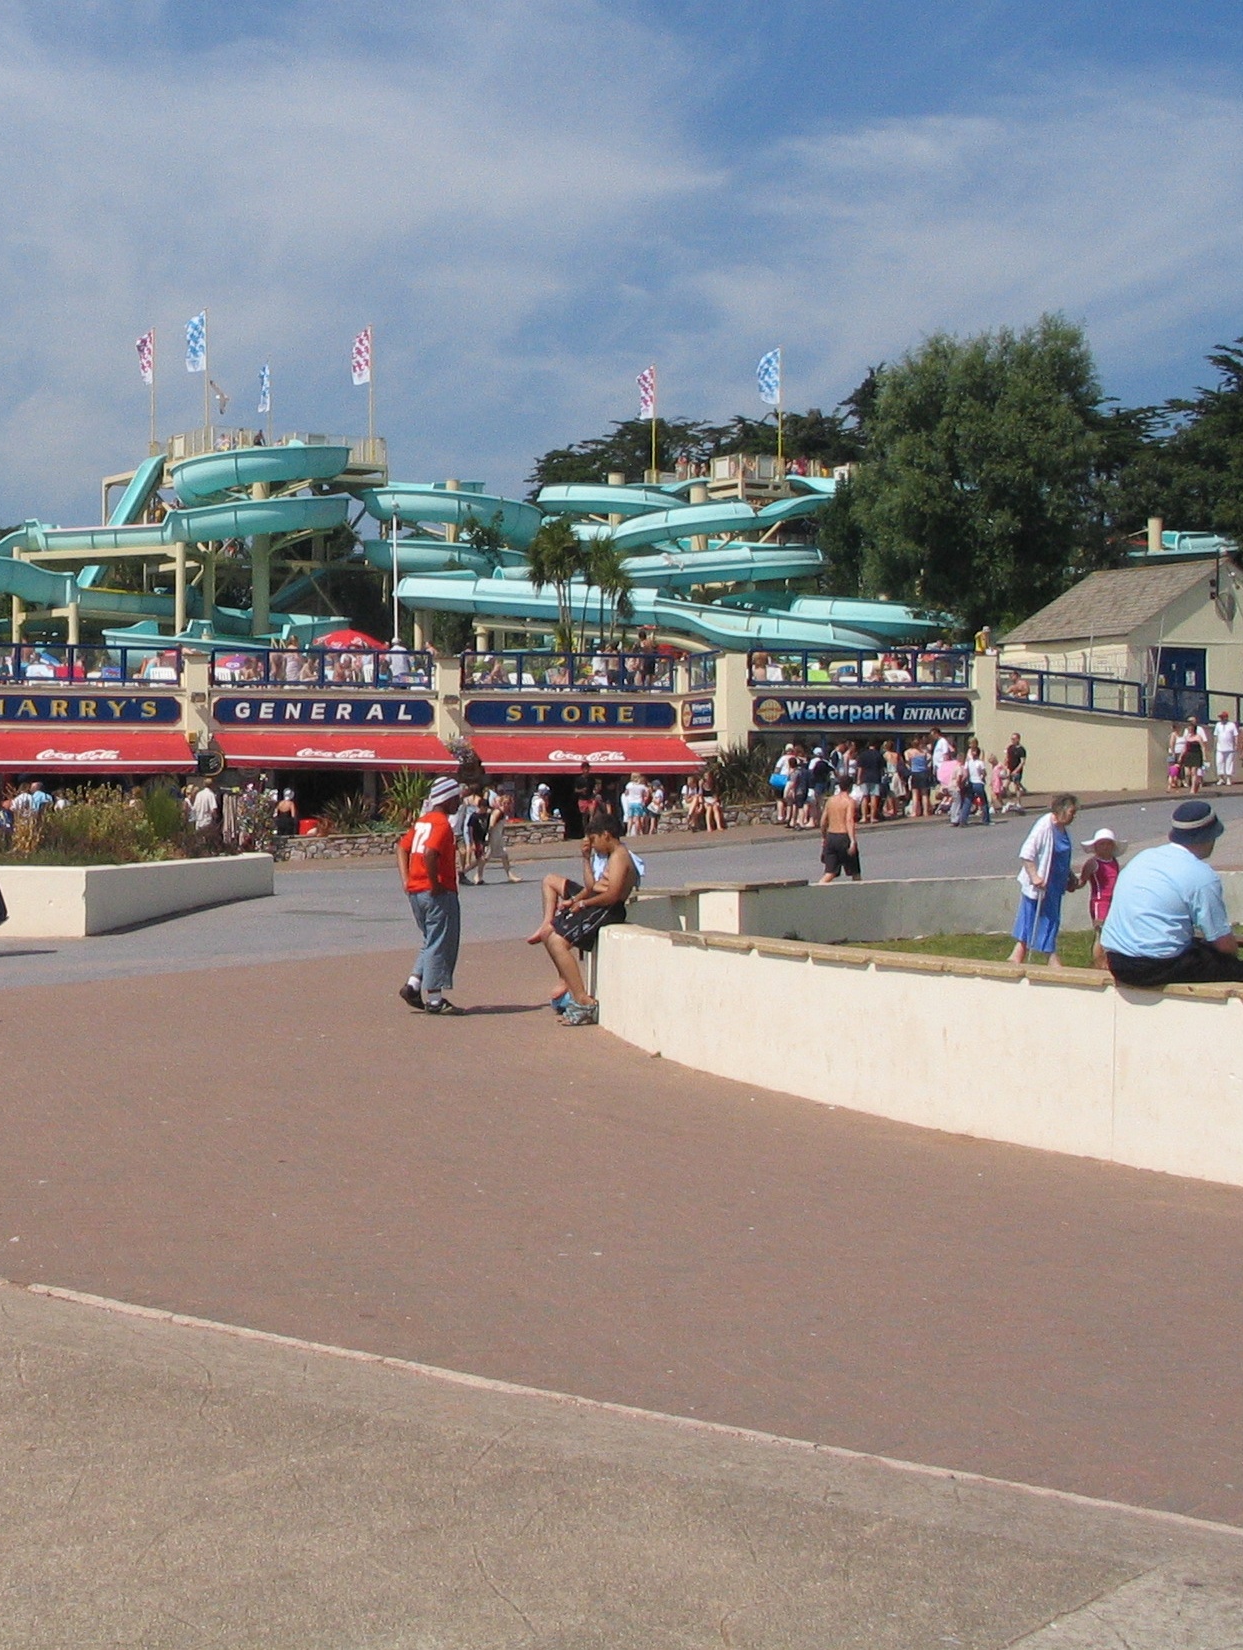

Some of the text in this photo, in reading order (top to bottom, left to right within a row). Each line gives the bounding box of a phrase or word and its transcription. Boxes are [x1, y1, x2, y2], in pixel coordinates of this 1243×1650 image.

[235, 702, 413, 721] GENERAL
[506, 705, 634, 723] STORE
[786, 700, 896, 723] Waterpark
[902, 706, 967, 721] ENTRANCE
[35, 748, 120, 761] Coca-Cola
[296, 747, 376, 759] Coca-Cola
[548, 750, 626, 761] Coca-Cola
